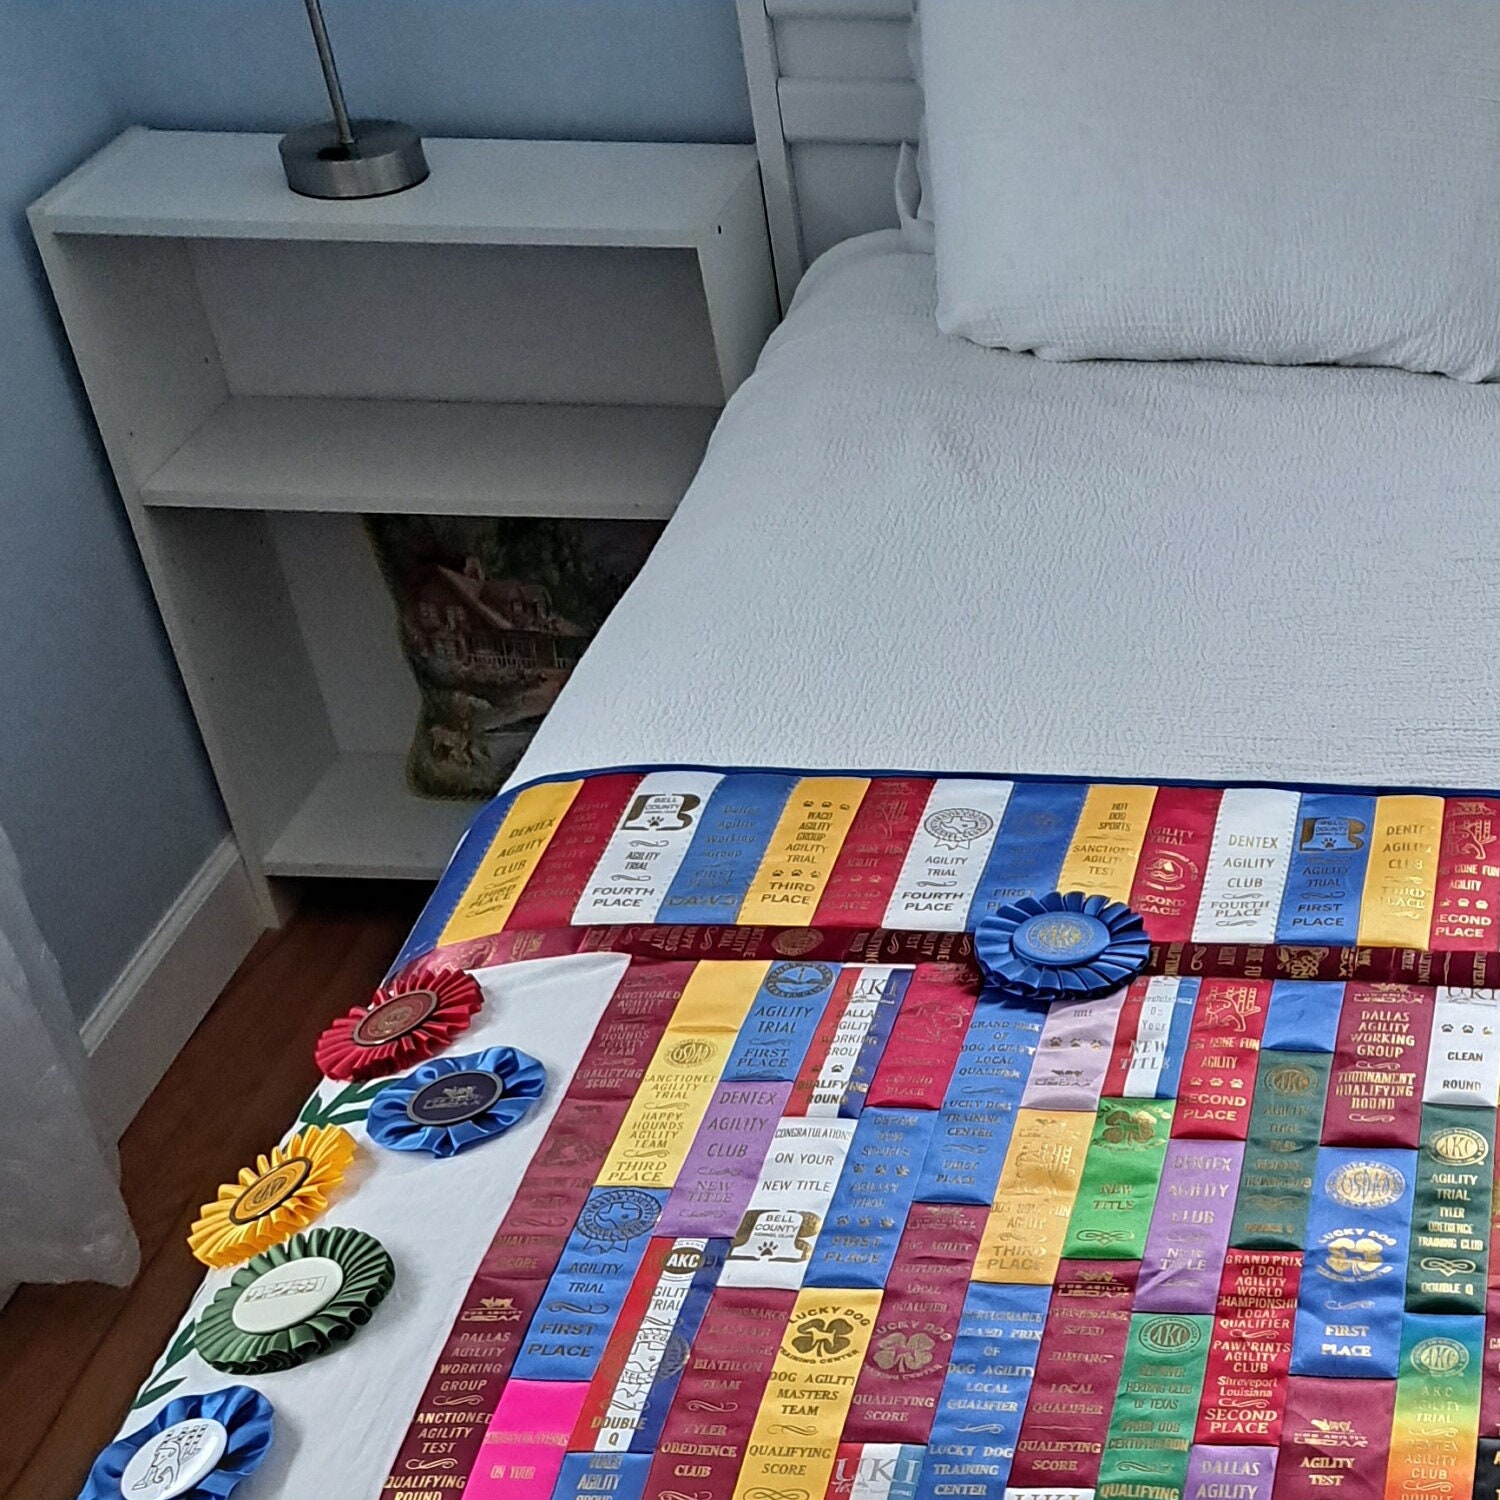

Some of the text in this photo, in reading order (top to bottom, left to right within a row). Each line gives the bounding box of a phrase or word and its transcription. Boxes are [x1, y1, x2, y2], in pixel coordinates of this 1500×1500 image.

[508, 818, 557, 839] DENTEX
[496, 838, 548, 858] AGILITY
[1228, 833, 1279, 850] DENTEX
[925, 856, 968, 865] AGILITY
[1223, 856, 1276, 870] AGILITY
[492, 860, 527, 876] CLUB
[927, 868, 958, 877] TRIAL
[768, 882, 816, 892] THIRD
[1227, 877, 1264, 889] CLUB
[592, 886, 656, 908] FOURTH PLACE
[761, 893, 811, 905] PLACE
[901, 892, 964, 900] FOURTH
[904, 903, 954, 912] PLACE
[1297, 903, 1343, 913] FIRST
[1292, 917, 1345, 927] PLACE
[719, 1091, 778, 1106] DENTEX
[707, 1118, 769, 1131] AGILITY
[706, 1143, 748, 1157] CLUB
[775, 1153, 834, 1166] ON YOUR
[762, 1180, 832, 1192] NEW TITLE
[766, 1214, 795, 1223] BELL
[754, 1223, 799, 1233] COUNTY
[666, 1253, 701, 1268] AKC
[789, 1306, 871, 1327] LUCKY DOG
[1220, 1319, 1290, 1329] QUALIFIER
[1217, 1376, 1278, 1389] Shreveport
[777, 1388, 839, 1401] MASTERS
[1219, 1386, 1273, 1398] Louisiana
[782, 1405, 819, 1416] TEAM
[1205, 1409, 1277, 1422] SECOND
[591, 1416, 648, 1431] DOUBLE
[1210, 1422, 1268, 1434] PLACE
[418, 1426, 474, 1439] AGILITY
[608, 1432, 619, 1446] Q
[421, 1442, 456, 1454] TEST
[762, 1463, 807, 1476] SCORE
[1202, 1461, 1260, 1476] DALLAS
[1195, 1484, 1258, 1499] AGILITY
